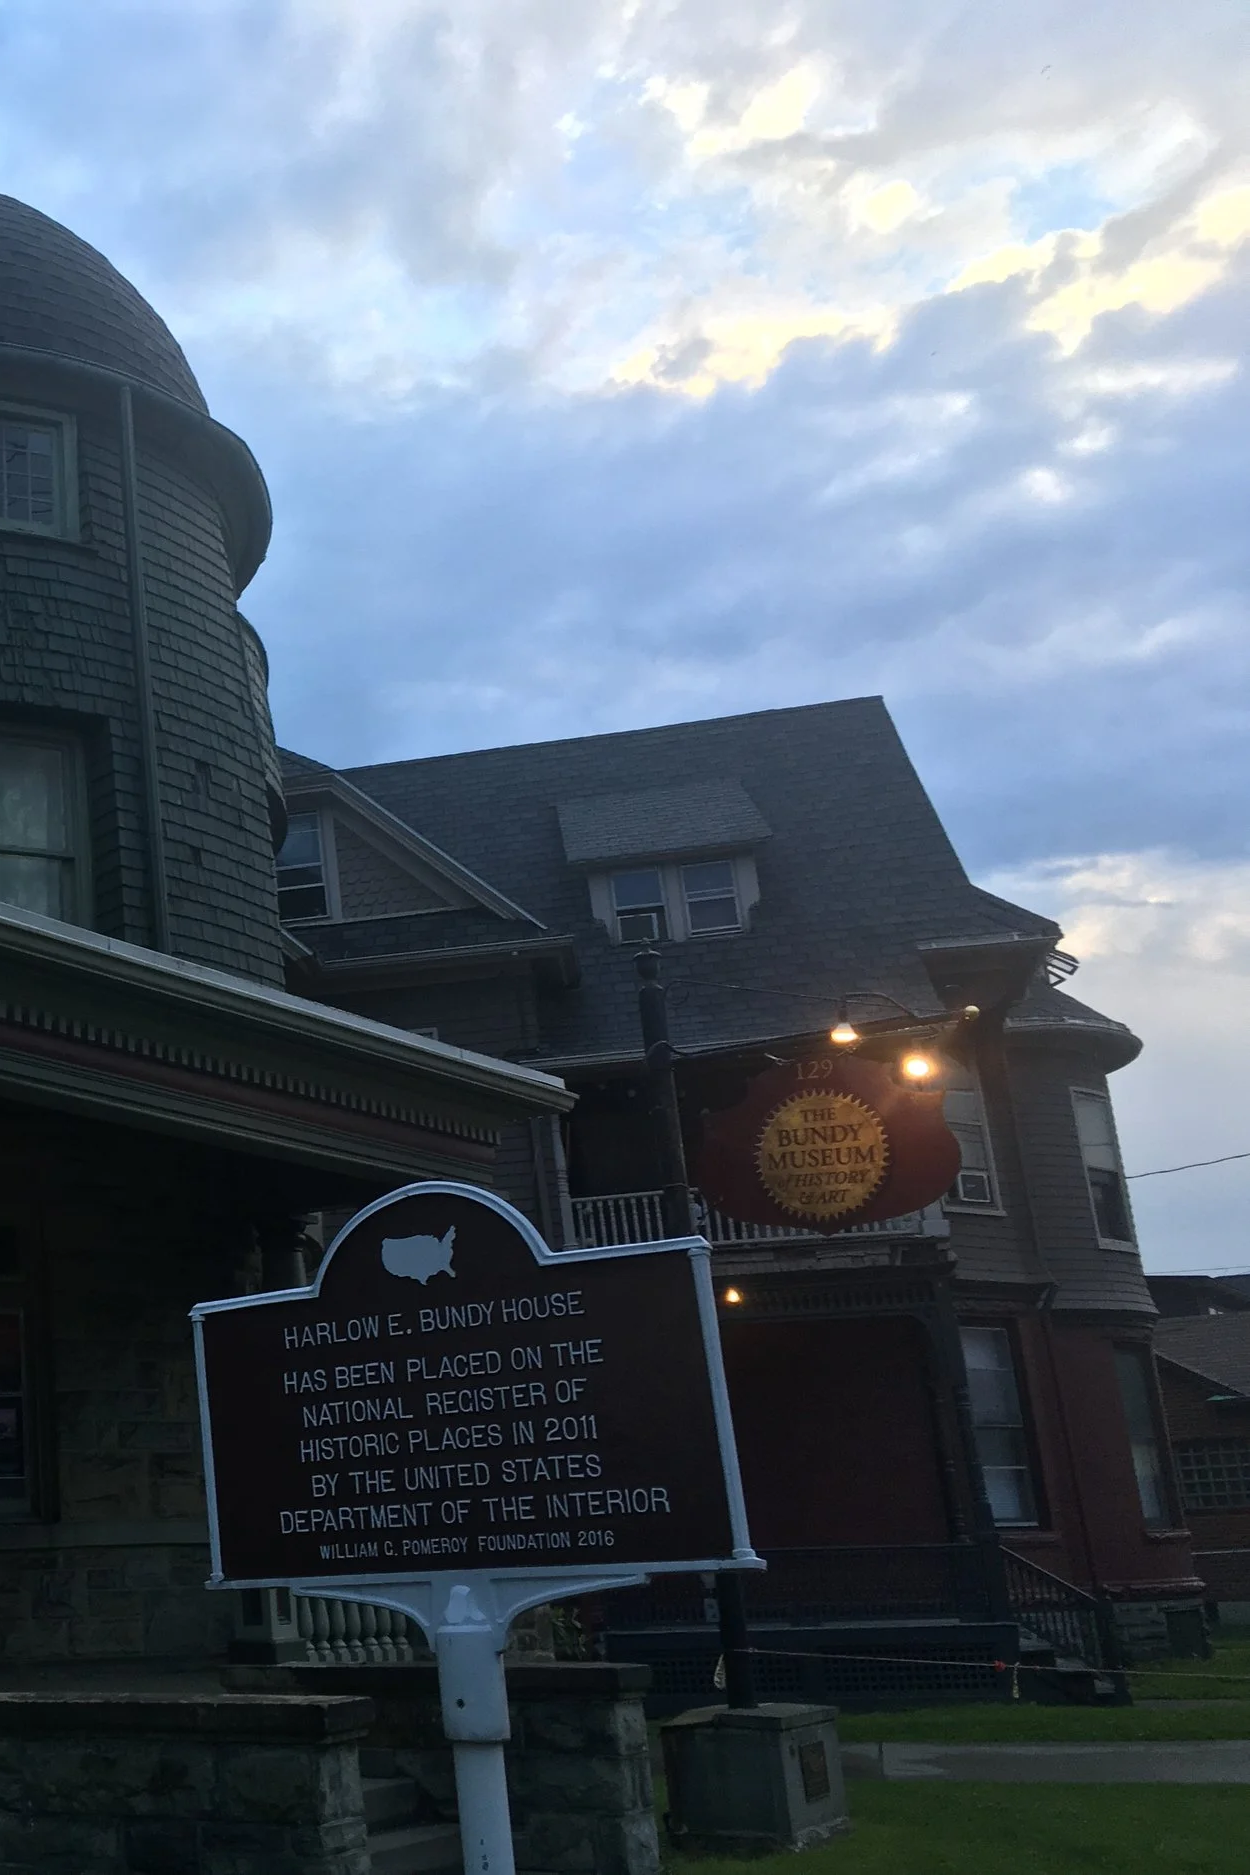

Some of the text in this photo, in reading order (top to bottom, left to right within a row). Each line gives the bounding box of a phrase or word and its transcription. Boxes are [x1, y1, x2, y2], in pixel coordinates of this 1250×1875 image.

[796, 1059, 833, 1080] 129
[800, 1108, 836, 1123] THE
[777, 1124, 862, 1147] BUNDY
[768, 1144, 877, 1170] MUSEUM
[778, 1169, 871, 1189] of HISTORY
[798, 1189, 850, 1204] & ART
[284, 1291, 585, 1349] HARLOW E. BUNDY HOUSE
[283, 1339, 603, 1394] HAS BEEN PLACED ON THE
[303, 1378, 587, 1428] NATIONAL REGISTER OF
[300, 1415, 598, 1463] HISTORIC PLACES IN 2011
[311, 1455, 602, 1498] BY THE UNITED STATES
[279, 1487, 671, 1535] DEPARTMENT OF THE INTERIOR
[319, 1530, 614, 1560] WILLIAM G. POMEROY FOUNDATION 2016
